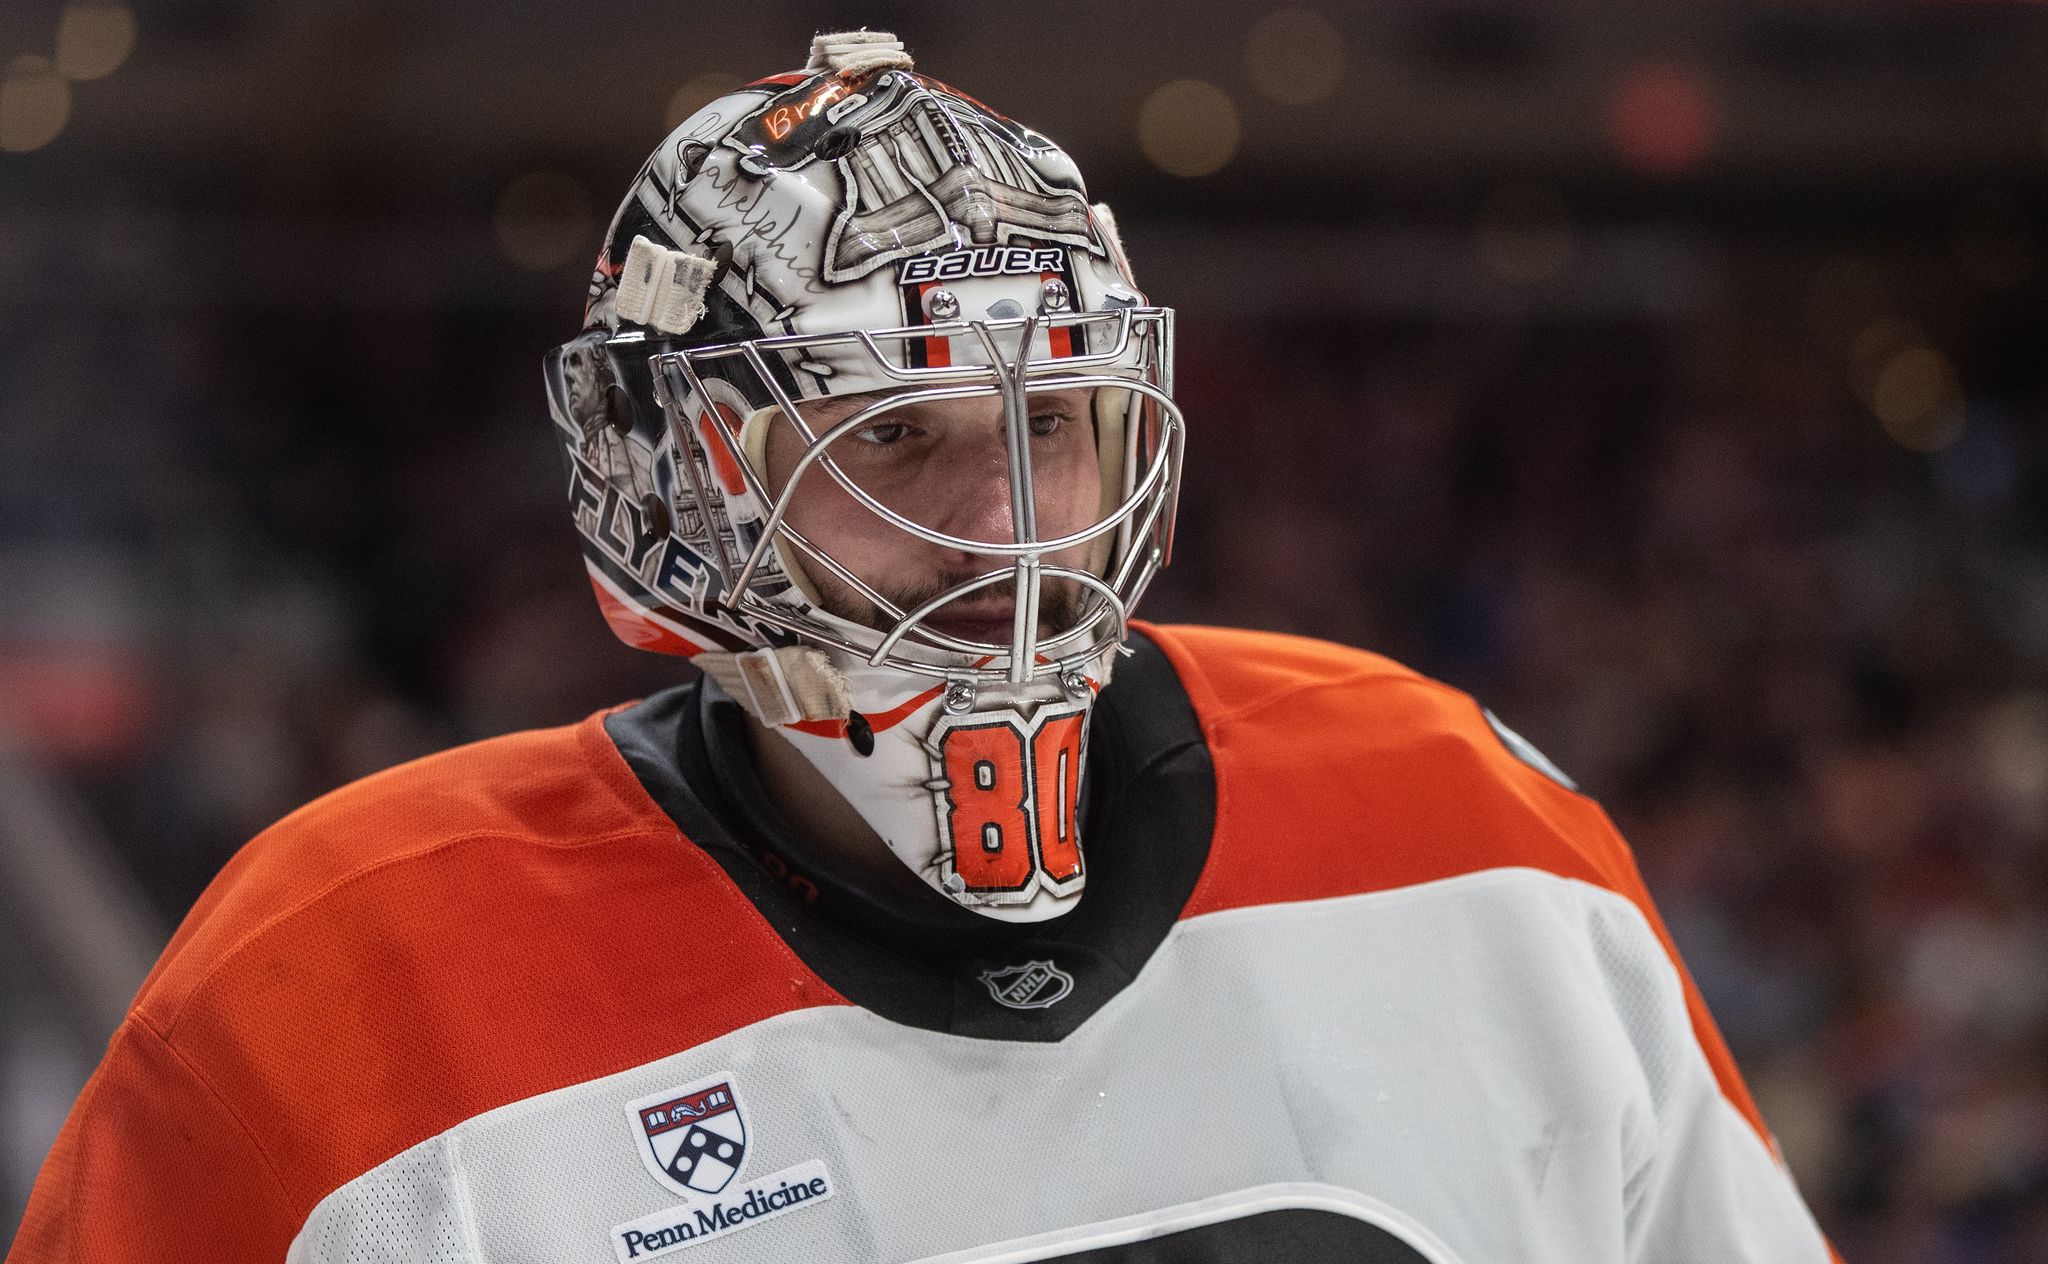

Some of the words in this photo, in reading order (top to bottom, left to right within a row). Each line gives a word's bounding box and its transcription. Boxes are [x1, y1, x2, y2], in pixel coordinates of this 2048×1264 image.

[900, 247, 1065, 285] BAUER
[934, 705, 1087, 901] 80
[1009, 972, 1047, 1002] NHL
[621, 1220, 698, 1259] Penn
[693, 1176, 828, 1237] Medicine
